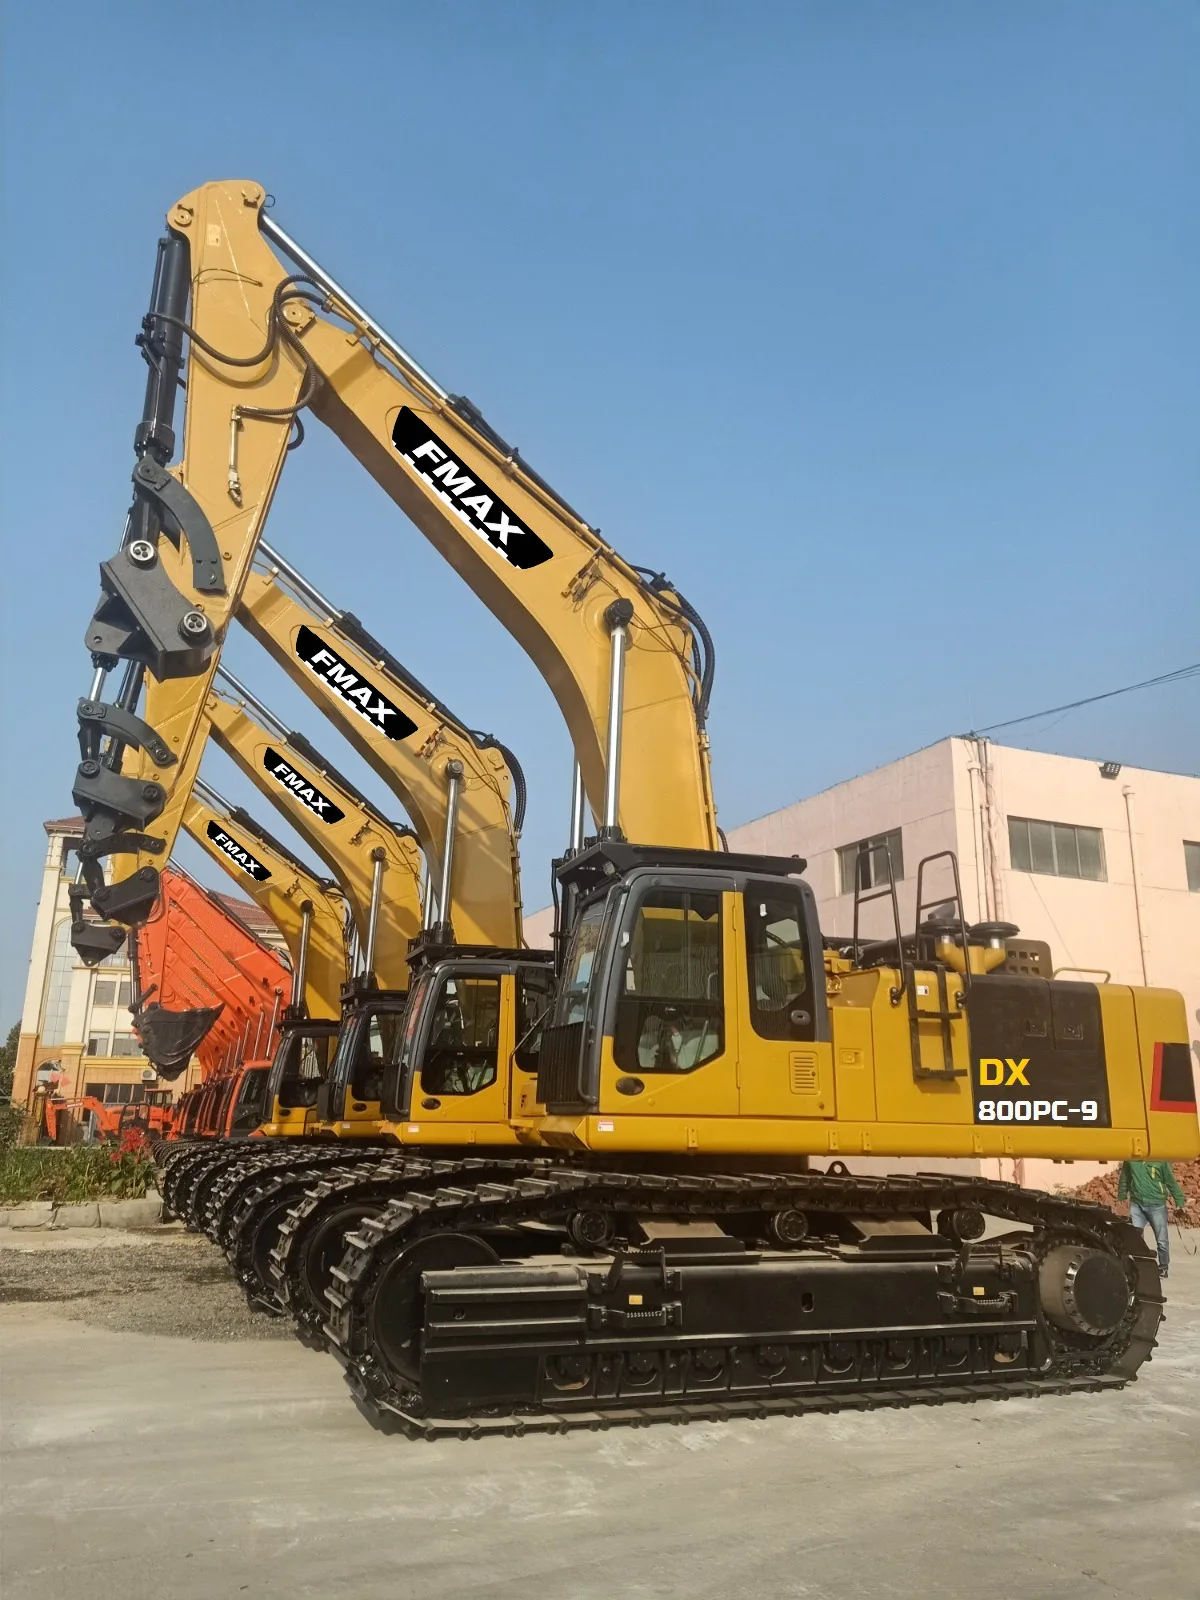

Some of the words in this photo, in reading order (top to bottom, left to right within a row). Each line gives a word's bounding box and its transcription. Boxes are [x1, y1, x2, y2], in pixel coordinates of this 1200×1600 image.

[412, 440, 525, 545] FMAX
[311, 649, 397, 724] FMAX
[274, 763, 331, 813] FMAX
[215, 833, 260, 872] FMAX
[979, 1059, 1030, 1085] DX
[979, 1101, 1098, 1120] 800PC-9
